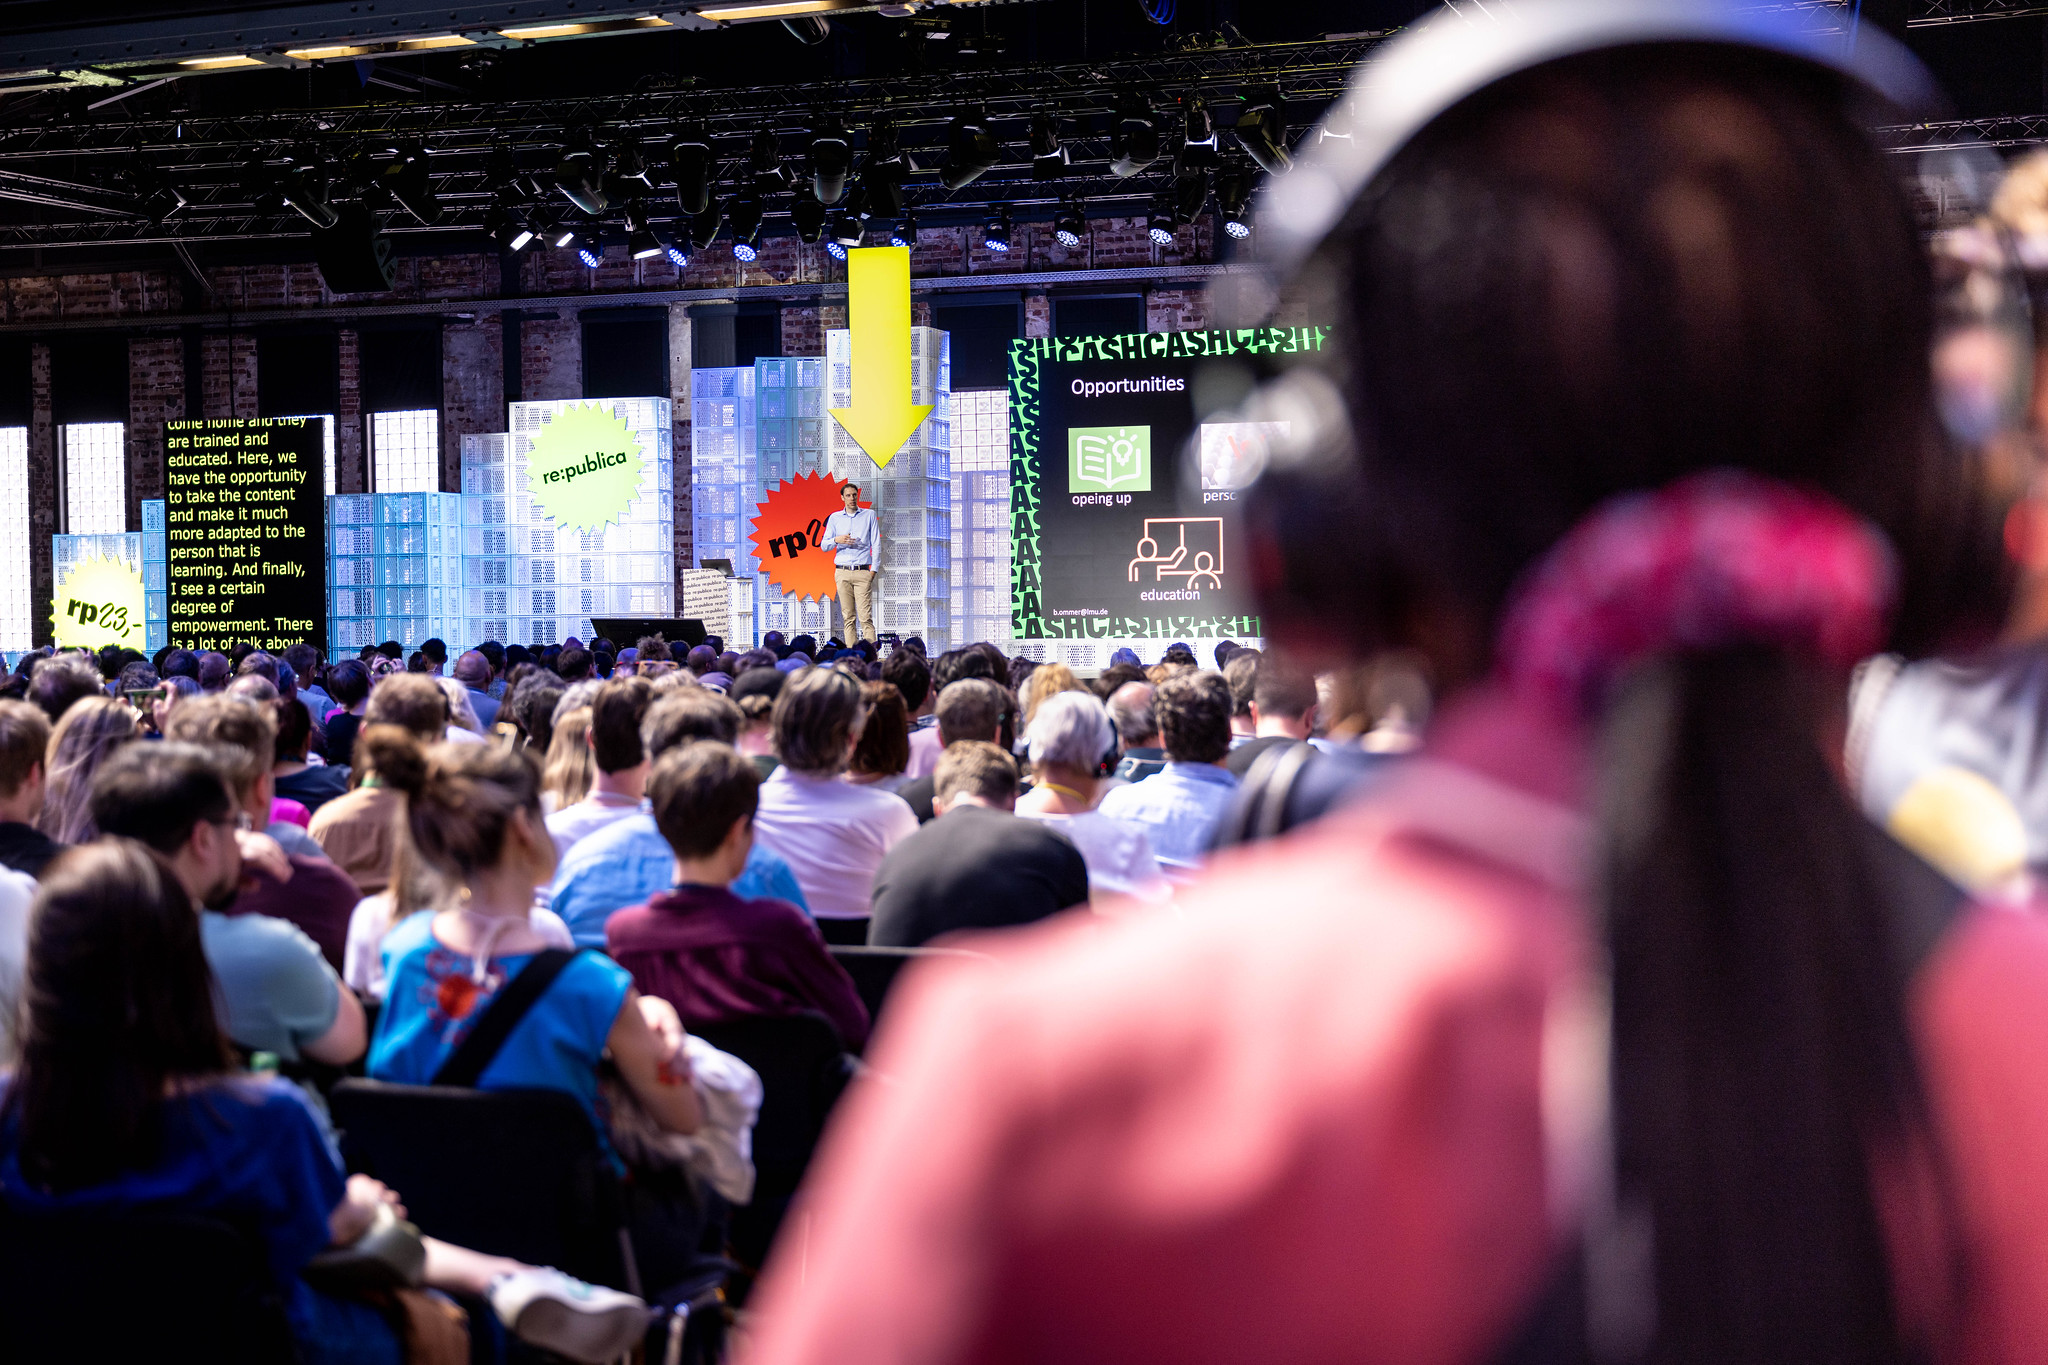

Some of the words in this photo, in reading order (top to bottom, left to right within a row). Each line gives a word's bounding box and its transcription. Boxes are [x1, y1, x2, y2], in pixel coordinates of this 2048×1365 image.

[1072, 376, 1184, 397] Opportunities
[168, 438, 189, 448] are
[194, 433, 239, 447] trained
[244, 432, 268, 446] and
[169, 452, 232, 467] educated.
[238, 452, 272, 466] Here,
[278, 453, 296, 463] we
[543, 452, 627, 484] re:publica
[169, 472, 200, 485] have
[204, 471, 225, 484] the
[230, 468, 306, 485] opportunity
[169, 491, 182, 503] to
[186, 490, 215, 503] take
[219, 489, 240, 502] the
[245, 488, 295, 501] content
[1071, 492, 1112, 507] opeing
[1116, 495, 1131, 506] up
[170, 508, 193, 522] and
[199, 508, 234, 521] make
[239, 507, 247, 520] it
[252, 506, 288, 519] much
[170, 529, 203, 540] more
[208, 525, 260, 541] adapted
[266, 526, 279, 538] to
[284, 524, 305, 537] the
[768, 514, 830, 559] rp2
[171, 548, 214, 561] person
[219, 544, 246, 557] that
[250, 544, 260, 557] is
[171, 564, 227, 578] learning.
[232, 562, 257, 575] And
[262, 561, 305, 577] finally,
[171, 583, 176, 595] I
[181, 585, 203, 595] see
[208, 584, 215, 595] a
[220, 581, 264, 594] certain
[1140, 587, 1201, 602] education
[172, 600, 216, 616] degree
[221, 600, 234, 613] of
[1053, 608, 1108, 616] b.ommer@lmu.de
[172, 618, 269, 634] empowerment.
[275, 617, 313, 630] There
[187, 640, 194, 650] a
[200, 637, 216, 650] lot
[220, 637, 233, 650] of
